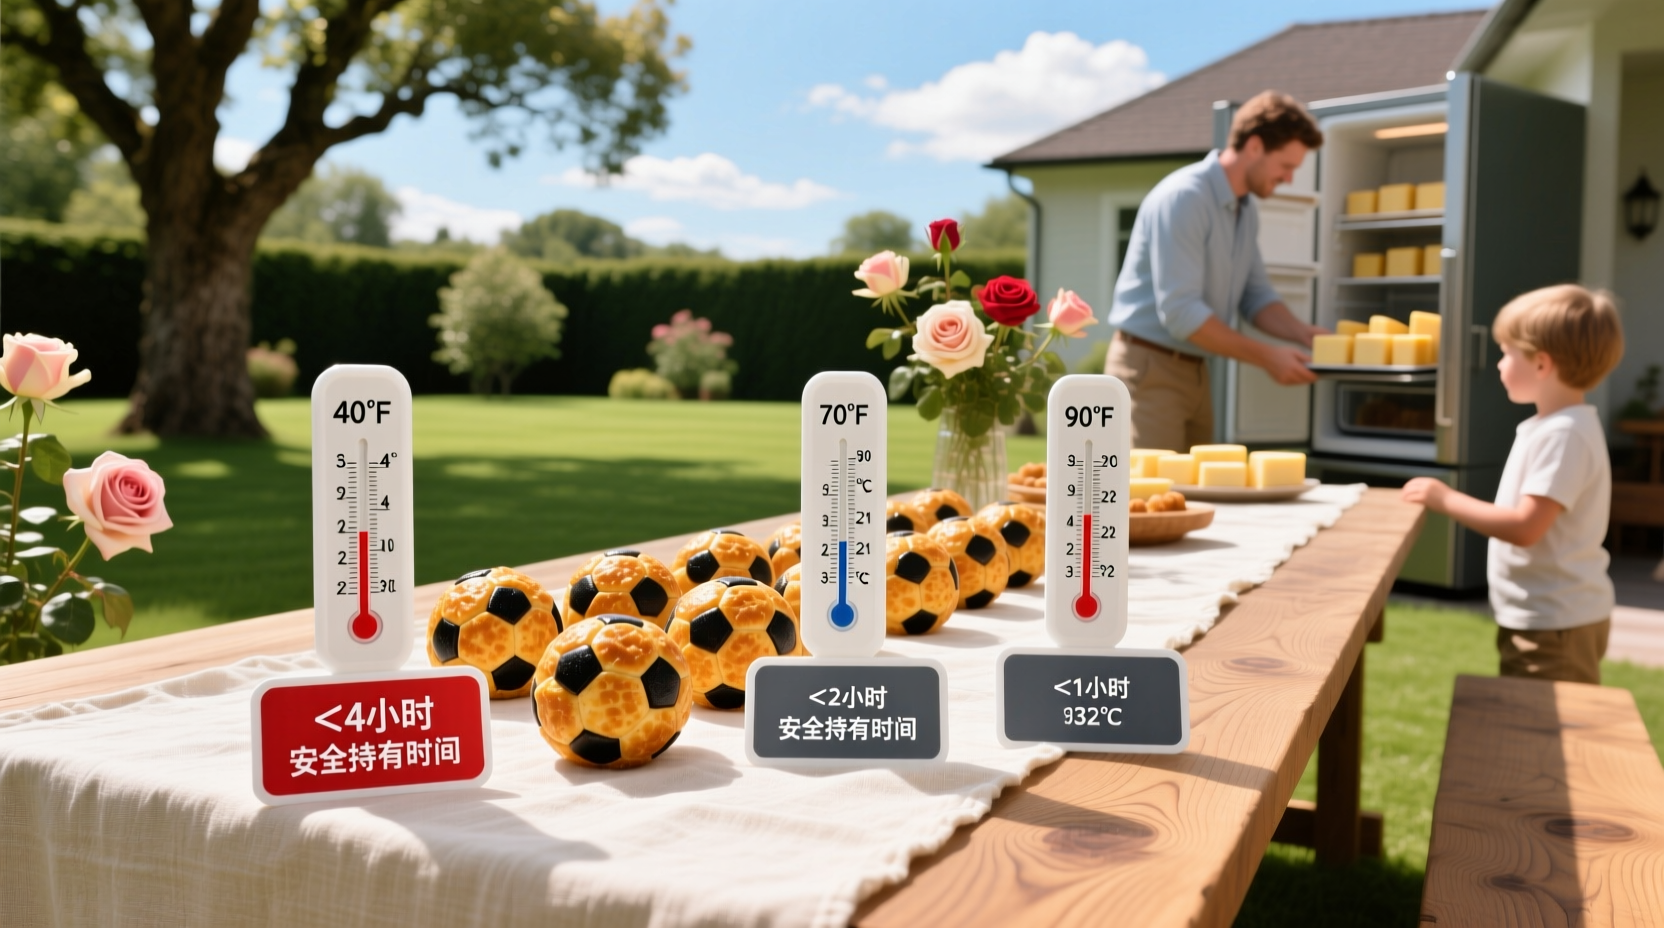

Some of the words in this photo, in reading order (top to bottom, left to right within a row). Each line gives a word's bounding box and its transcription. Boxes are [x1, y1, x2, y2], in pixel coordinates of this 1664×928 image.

[333, 399, 391, 424] 40°F
[819, 403, 869, 425] 70°F
[1065, 405, 1114, 428] 90°F
[337, 551, 347, 565] 2
[856, 542, 871, 555] 21
[1066, 542, 1074, 556] 2
[809, 685, 888, 709] <2小时
[1053, 675, 1130, 699] <1小时
[314, 695, 434, 733] <4小时
[778, 715, 917, 741] 安全持有时间
[289, 736, 461, 778] 安全持有时间
